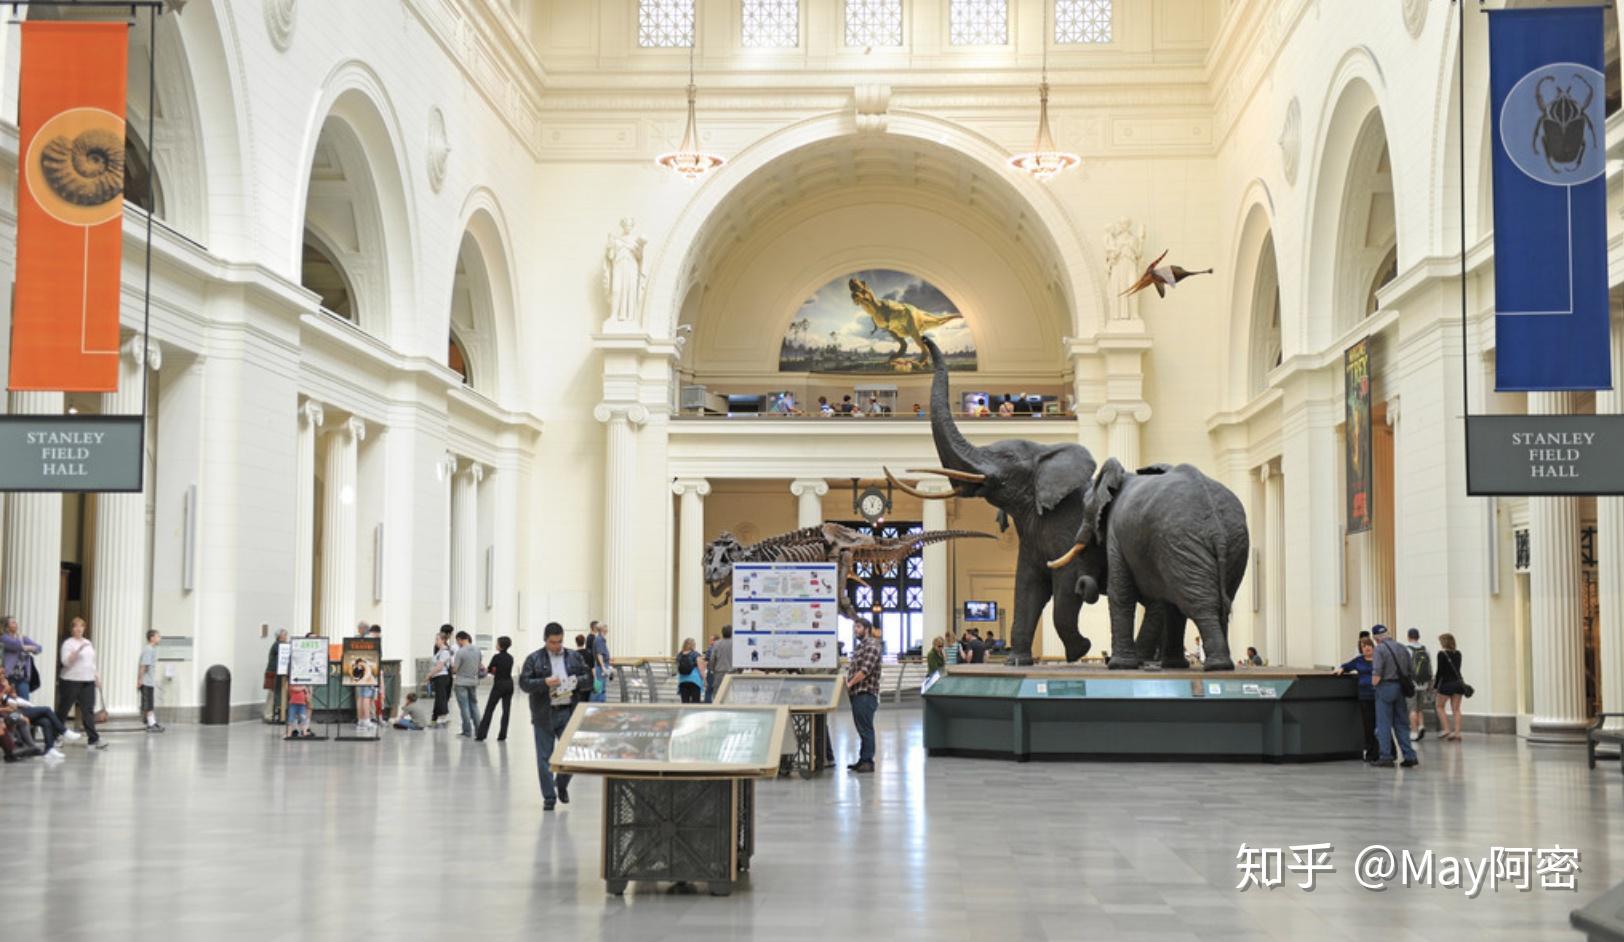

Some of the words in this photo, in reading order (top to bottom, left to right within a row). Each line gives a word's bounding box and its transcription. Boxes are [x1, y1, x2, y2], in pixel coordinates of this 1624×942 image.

[26, 431, 105, 444] STANLEY
[1512, 432, 1596, 445] STANLEY
[41, 447, 90, 460] FIELD
[1529, 448, 1580, 461] FIELD
[42, 463, 88, 476] HALL
[1531, 465, 1580, 477] HALL
